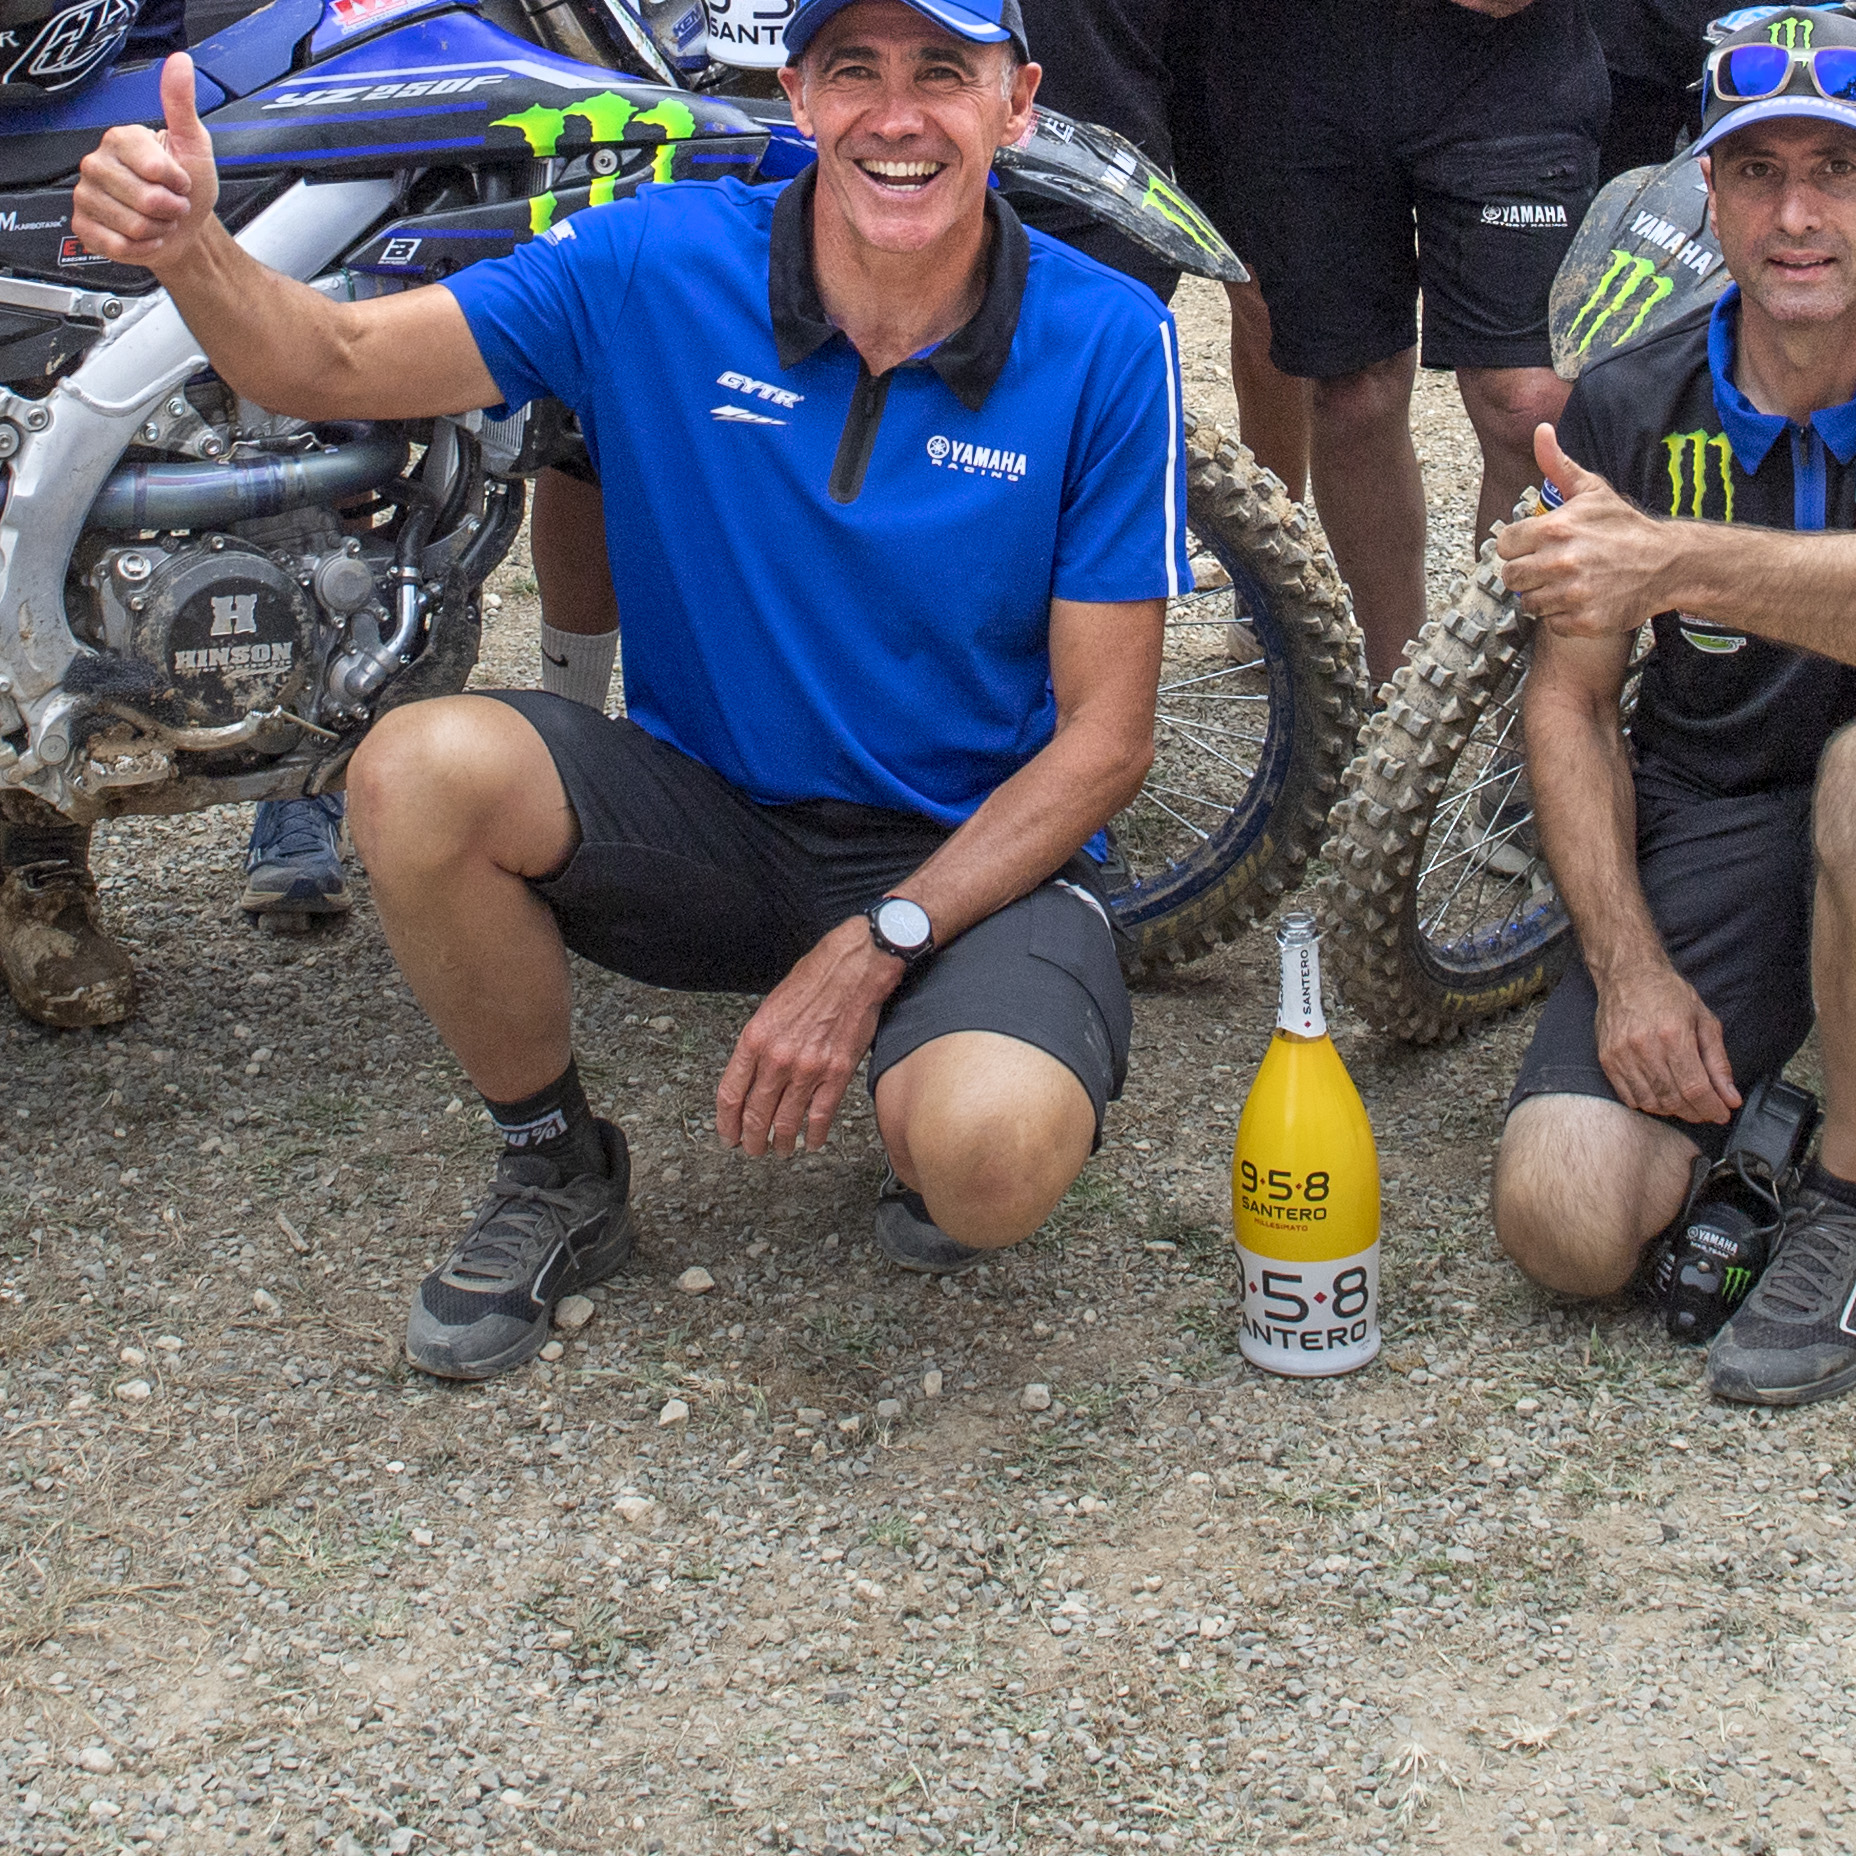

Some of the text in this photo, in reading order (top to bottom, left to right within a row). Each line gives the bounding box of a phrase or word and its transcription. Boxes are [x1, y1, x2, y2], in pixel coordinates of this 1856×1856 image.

[1503, 205, 1566, 224] YAMAHA
[1629, 211, 1713, 276] YAMAHA
[717, 371, 796, 409] GYTR
[932, 459, 1018, 481] RACING
[949, 440, 1027, 475] YAMAHA
[175, 643, 292, 670] HINSON
[1302, 948, 1311, 1016] SANTERO
[1242, 1199, 1327, 1221] SANTERO
[1253, 1219, 1308, 1232] MILLESIMATO
[1695, 1225, 1739, 1258] YAMAHA
